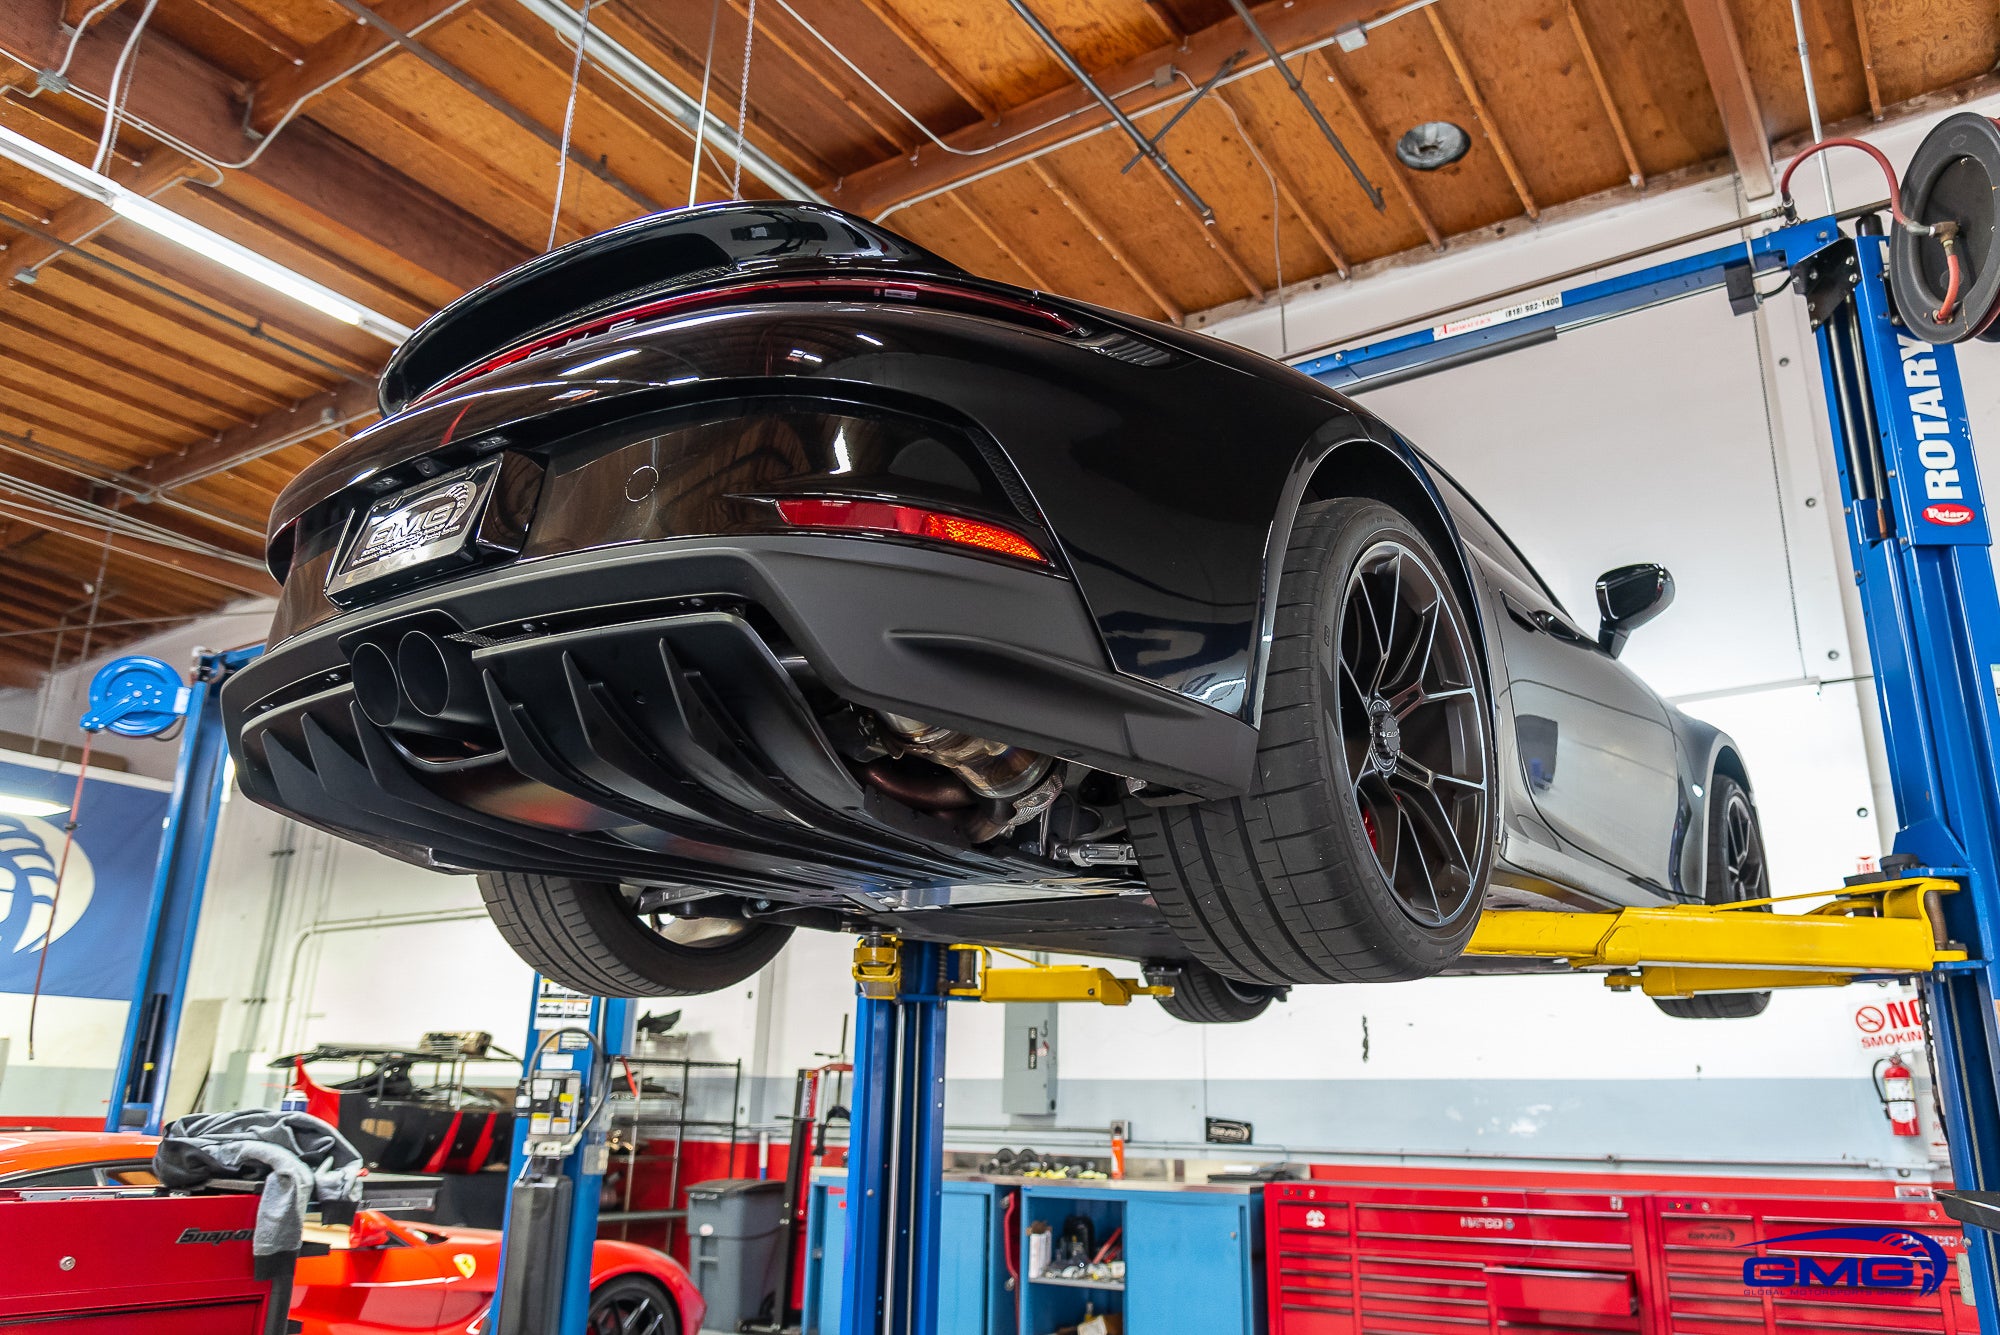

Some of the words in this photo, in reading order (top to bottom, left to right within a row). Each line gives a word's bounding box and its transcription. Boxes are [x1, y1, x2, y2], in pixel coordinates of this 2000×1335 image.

[1897, 333, 1963, 500] ROTARY
[1926, 507, 1970, 523] Rotary
[1861, 1031, 1922, 1049] SMOKIN
